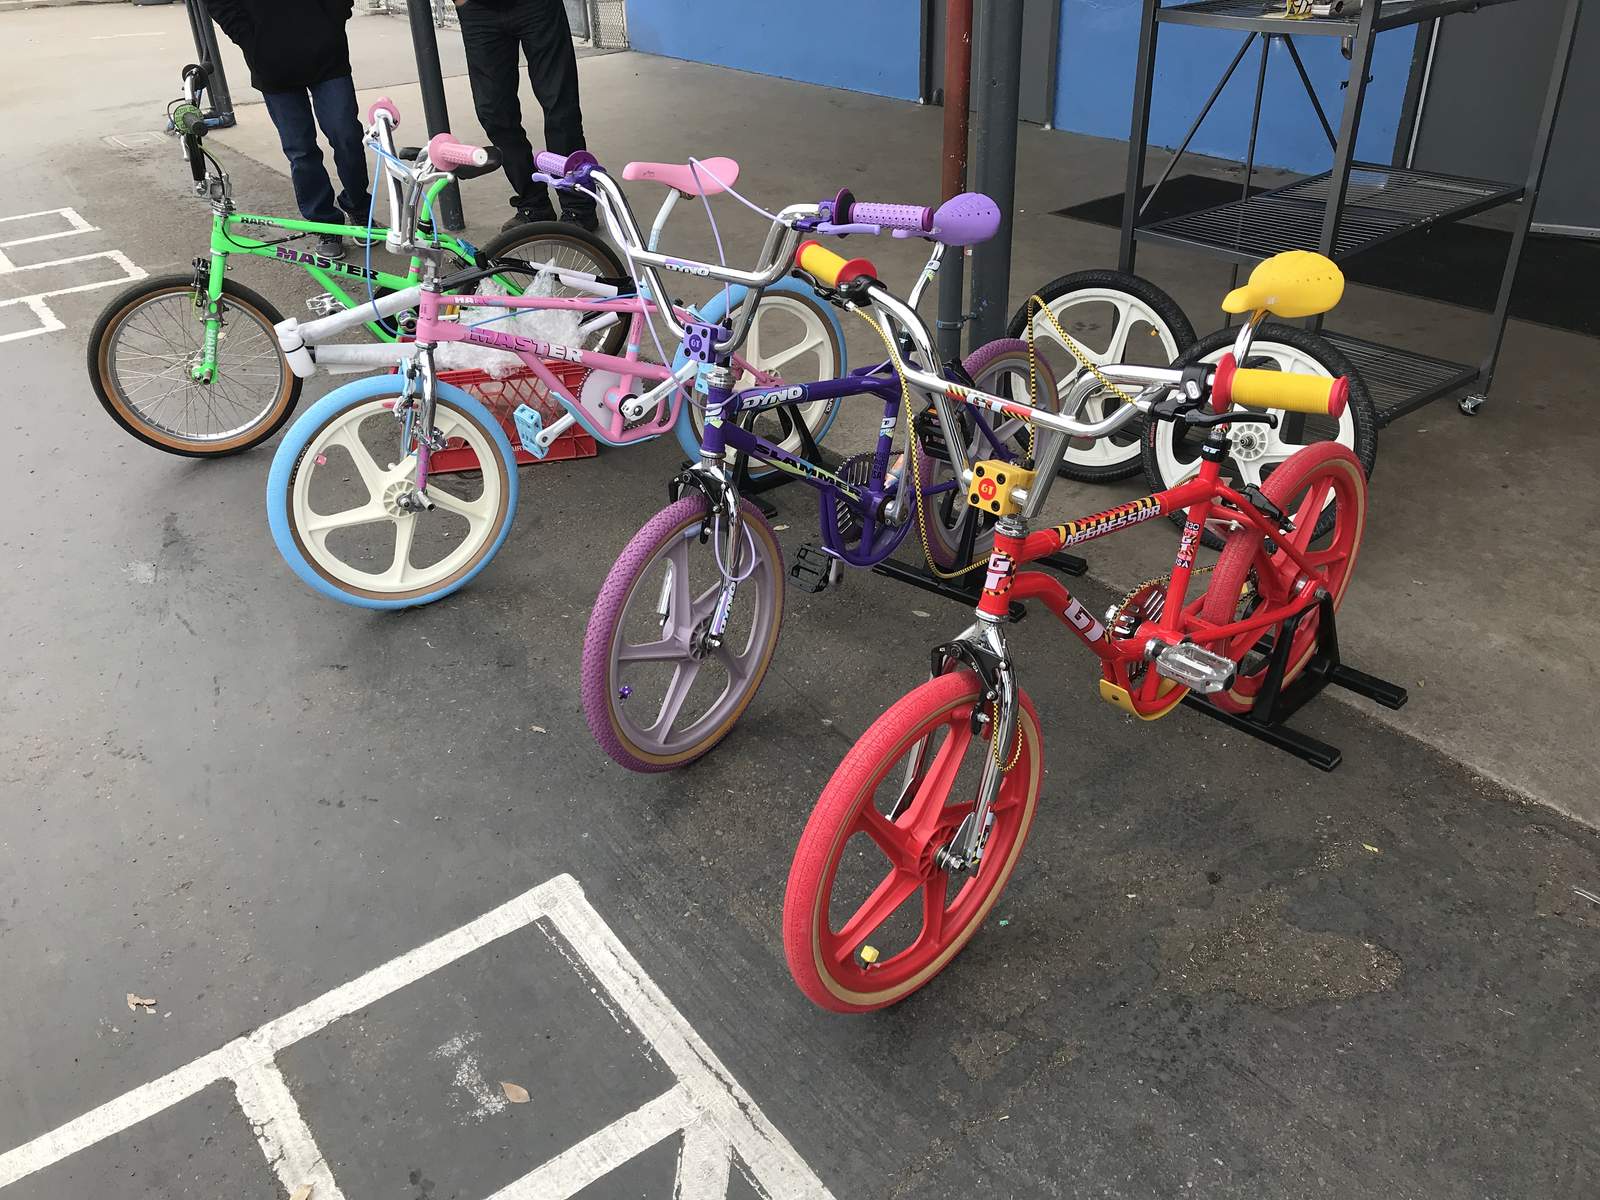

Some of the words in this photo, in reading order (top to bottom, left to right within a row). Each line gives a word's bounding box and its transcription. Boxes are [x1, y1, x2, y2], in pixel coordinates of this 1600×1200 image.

[276, 246, 379, 280] MASTER
[469, 328, 583, 363] MASTER
[691, 338, 701, 348] GT
[742, 385, 803, 409] DYNO
[754, 443, 862, 501] SLAMMER
[980, 483, 995, 496] GT
[1063, 504, 1161, 548] AGGRESSOR
[986, 552, 1011, 590] GT
[1064, 600, 1104, 642] GT
